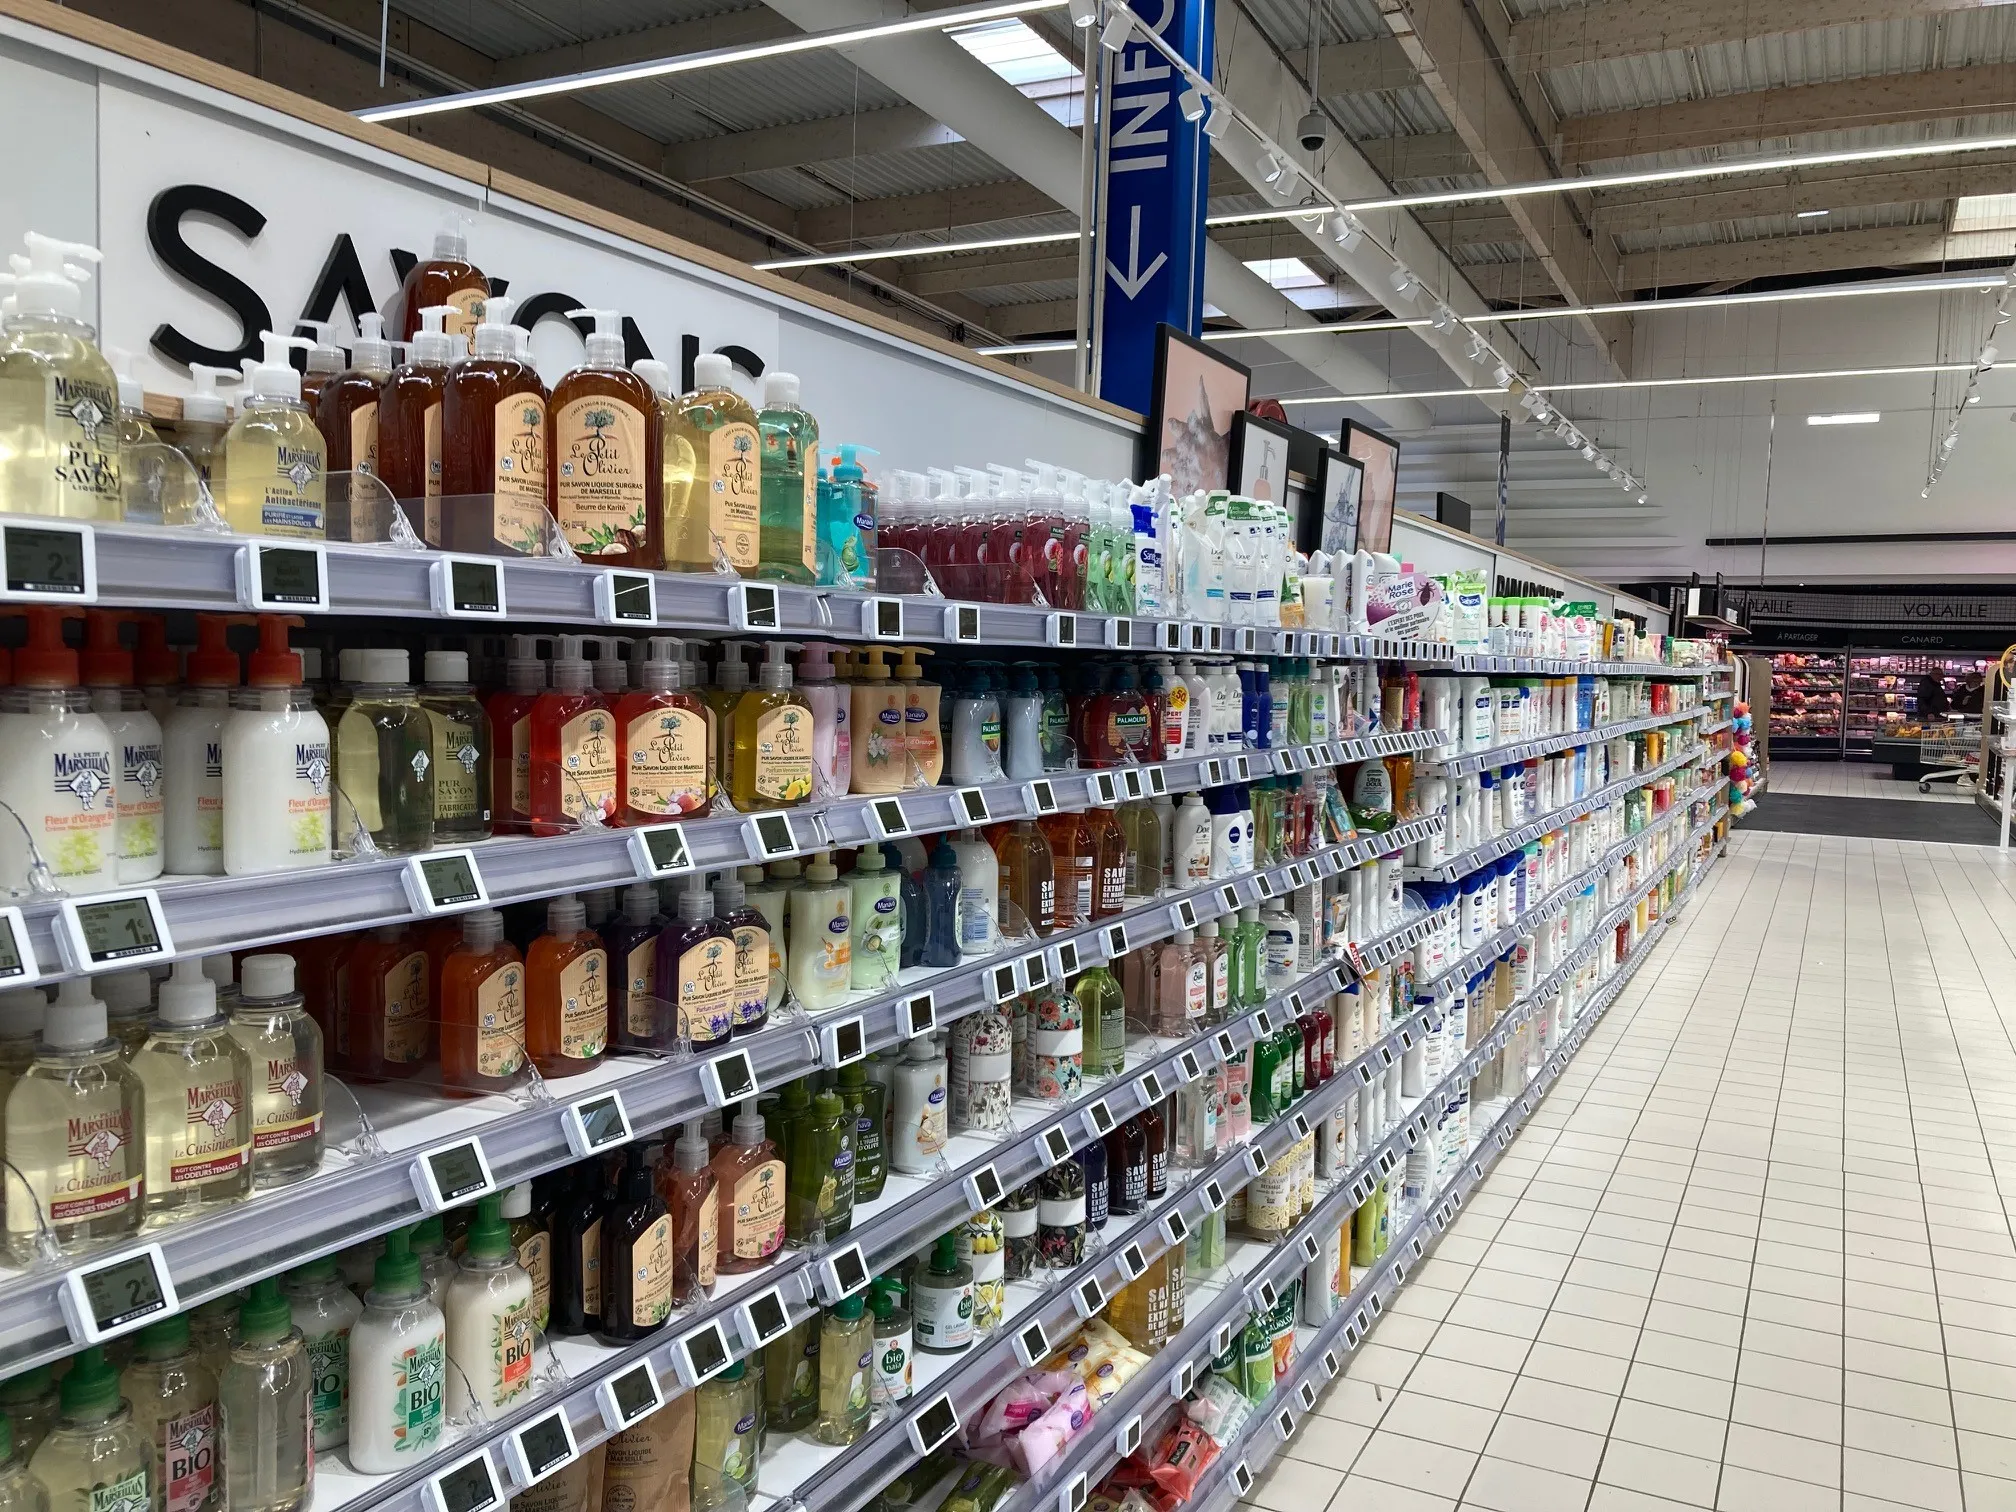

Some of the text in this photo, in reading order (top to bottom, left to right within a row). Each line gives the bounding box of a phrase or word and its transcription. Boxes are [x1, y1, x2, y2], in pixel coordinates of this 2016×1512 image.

[570, 438, 620, 460] Le Petit
[68, 451, 109, 471] PUR
[582, 453, 631, 476] Olivier
[615, 482, 643, 490] SURGRAS
[576, 503, 596, 511] Beurre
[607, 503, 627, 511] Karité
[1388, 581, 1413, 592] Marie
[1389, 588, 1414, 599] Rose
[1902, 603, 1988, 618] VOLAILLE
[1784, 633, 1818, 642] PARTAGER
[1902, 635, 1944, 644] CANARD
[1117, 716, 1147, 724] PALMOLIVE
[649, 741, 661, 752] Le
[54, 752, 110, 777] MARSEILLAIS
[438, 780, 461, 788] PUR
[438, 787, 474, 795] SAVON
[288, 800, 306, 808] Fleur
[45, 816, 68, 825] Fleur
[256, 1118, 266, 1126] Le
[265, 1136, 290, 1146] ODEURS
[290, 1130, 312, 1140] TENACES
[175, 1137, 236, 1158] Le Cuisinier
[175, 1163, 212, 1174] AGIT CONTRE
[184, 1168, 214, 1180] ODEURS
[214, 1161, 238, 1176] TENACES
[64, 1203, 95, 1217] ODEURS
[96, 1197, 126, 1211] TENACES
[960, 1301, 972, 1310] bio
[506, 1338, 531, 1366] BIO
[886, 1352, 903, 1364] bio
[411, 1381, 441, 1411] BIO
[172, 1450, 211, 1481] BIO
